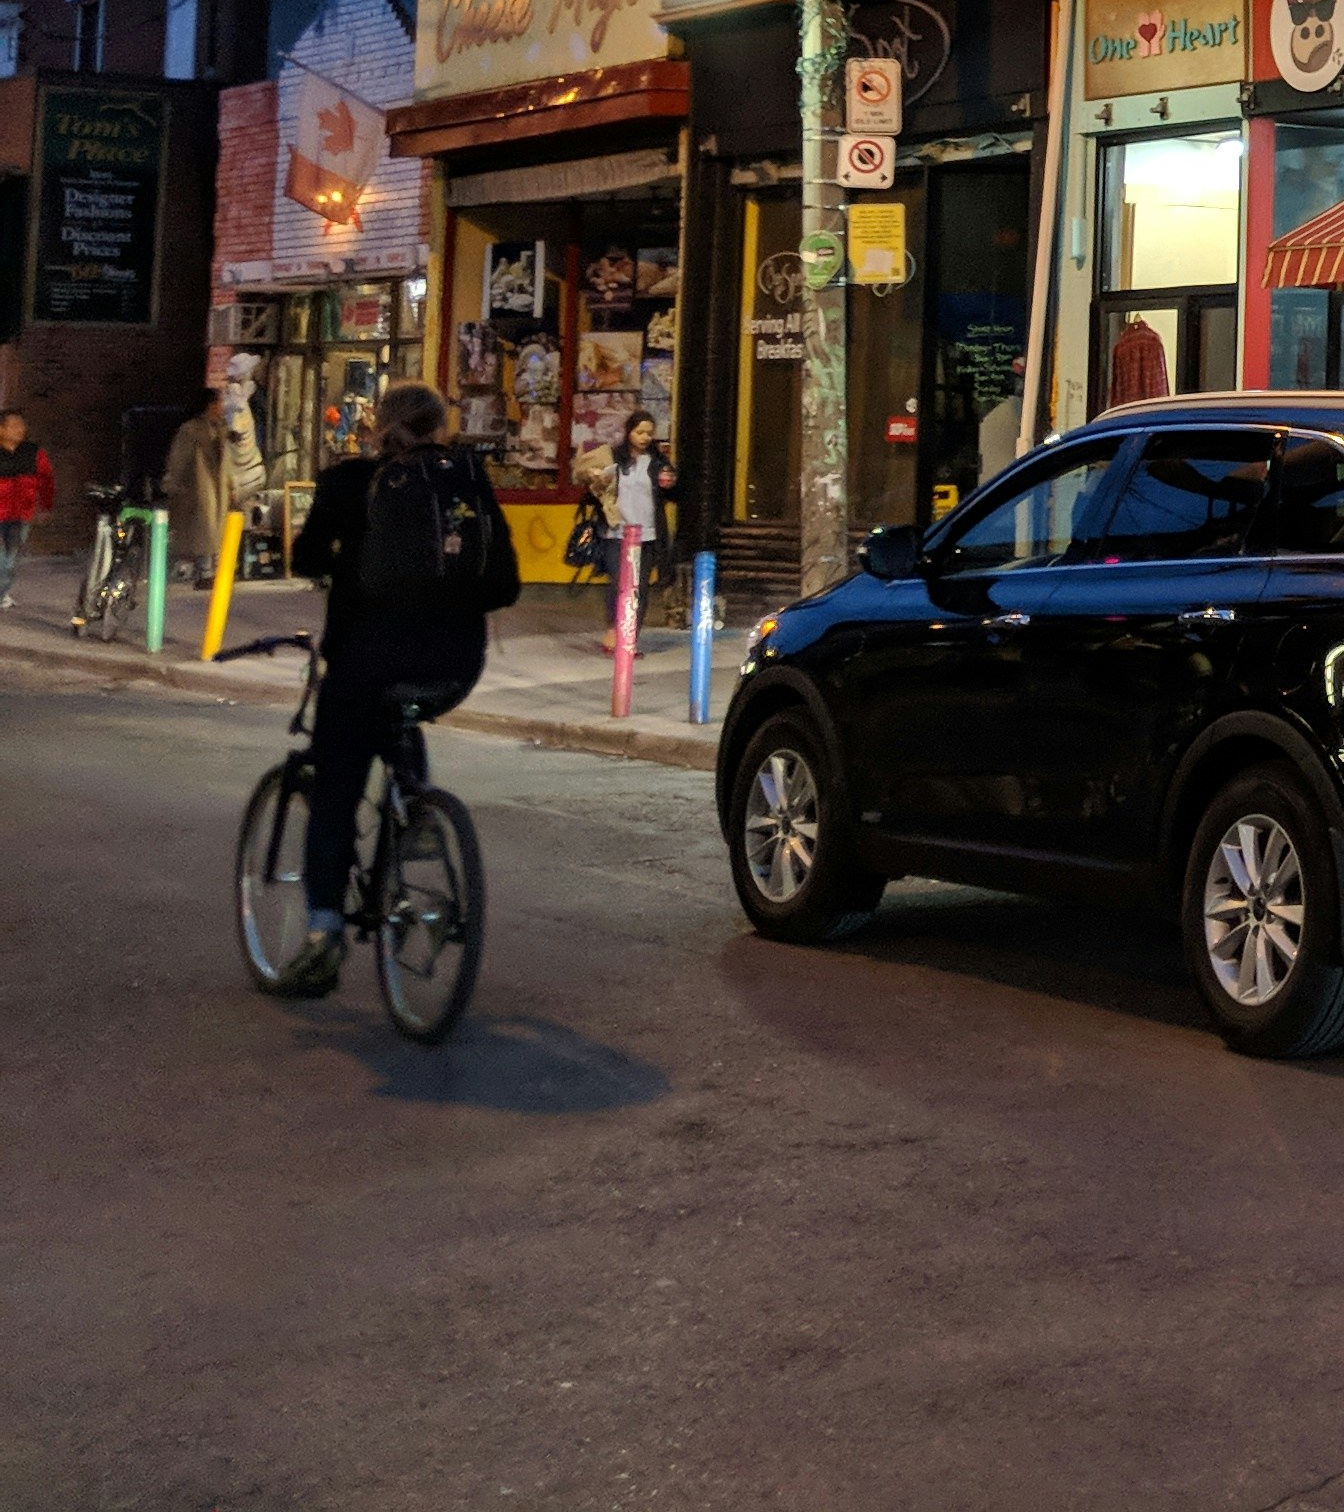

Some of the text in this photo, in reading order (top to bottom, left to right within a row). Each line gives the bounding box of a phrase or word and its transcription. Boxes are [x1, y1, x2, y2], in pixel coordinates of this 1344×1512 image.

[1088, 14, 1241, 65] One Heart
[56, 113, 141, 138] Tom's
[67, 139, 149, 163] Place
[746, 313, 784, 339] erving
[756, 338, 805, 360] Breakfas
